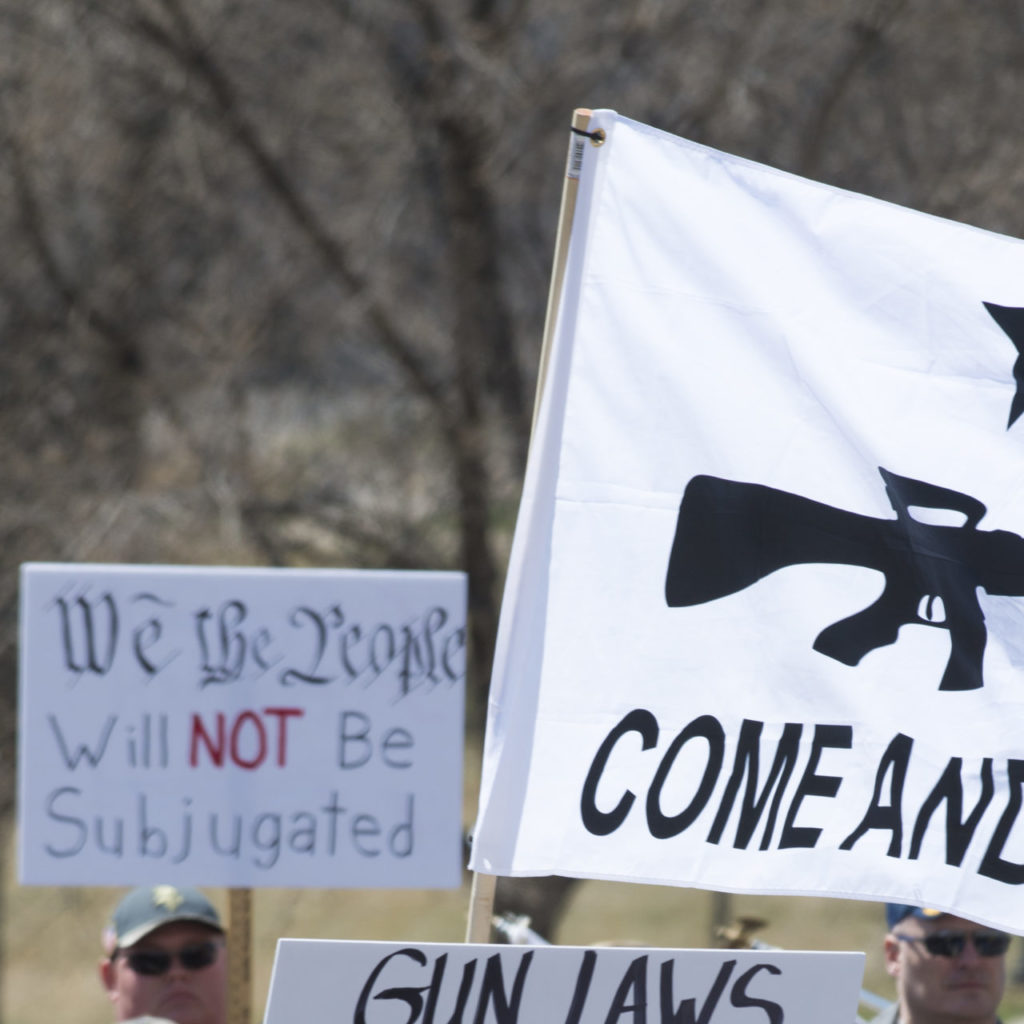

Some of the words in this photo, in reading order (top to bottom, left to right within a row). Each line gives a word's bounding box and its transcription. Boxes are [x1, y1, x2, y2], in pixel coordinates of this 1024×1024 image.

[50, 583, 180, 688] We
[279, 603, 468, 703] People
[46, 712, 169, 772] Will
[188, 707, 305, 771] NOT
[336, 709, 415, 770] Be
[580, 708, 854, 851] COME
[44, 786, 415, 870] Subjugated
